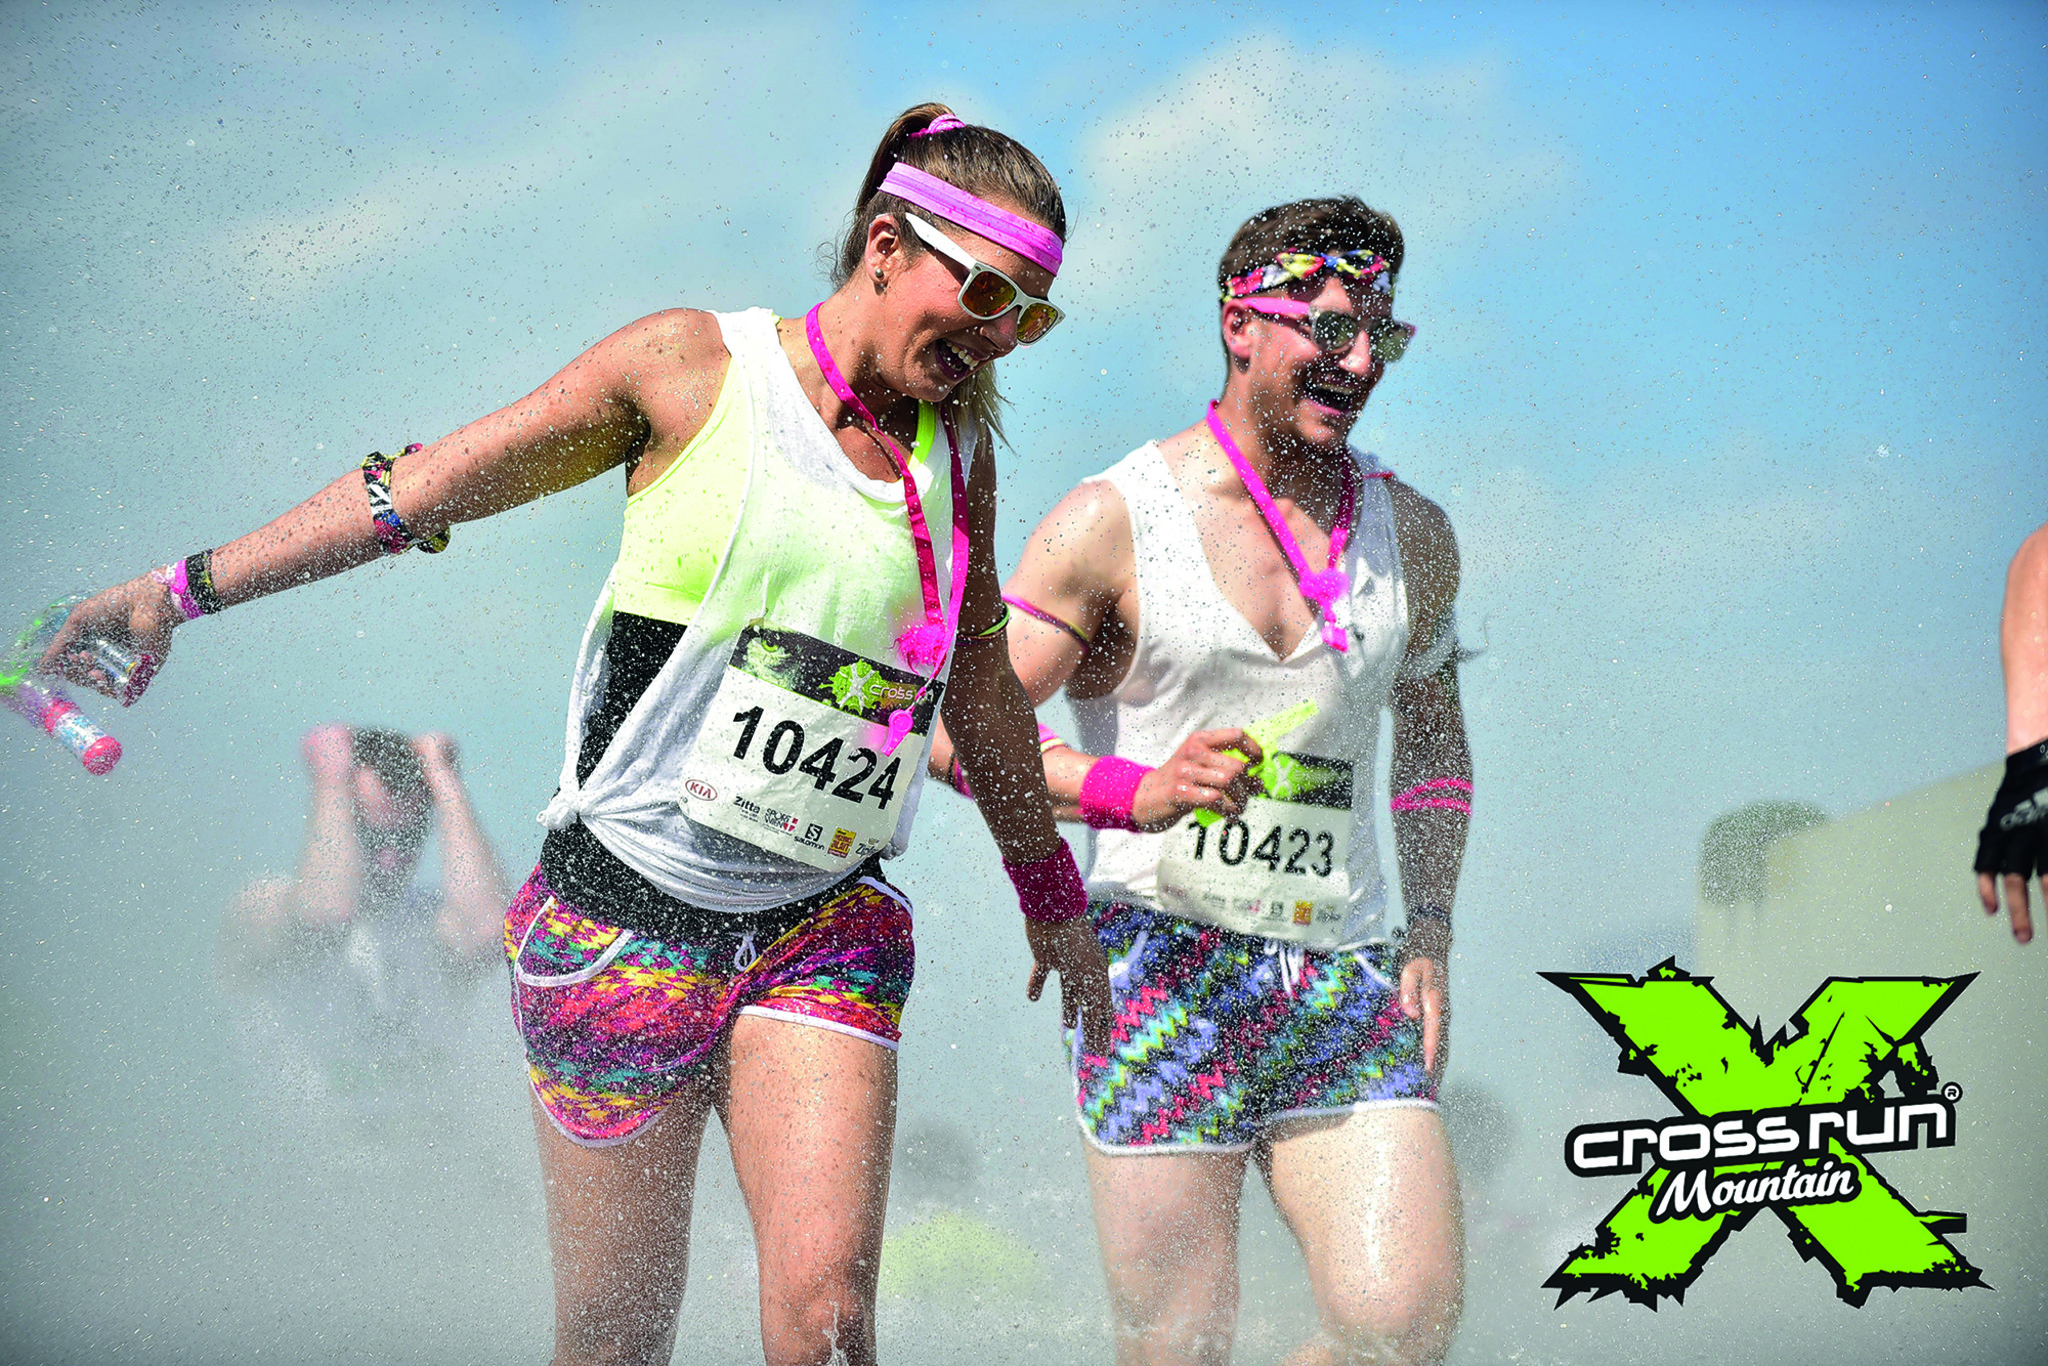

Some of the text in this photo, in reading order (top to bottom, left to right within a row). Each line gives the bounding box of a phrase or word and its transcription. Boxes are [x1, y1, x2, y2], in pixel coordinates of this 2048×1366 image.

[733, 705, 901, 810] 10424
[690, 781, 711, 798] KIA
[733, 796, 761, 814] Zitta
[1188, 819, 1334, 877] 10423
